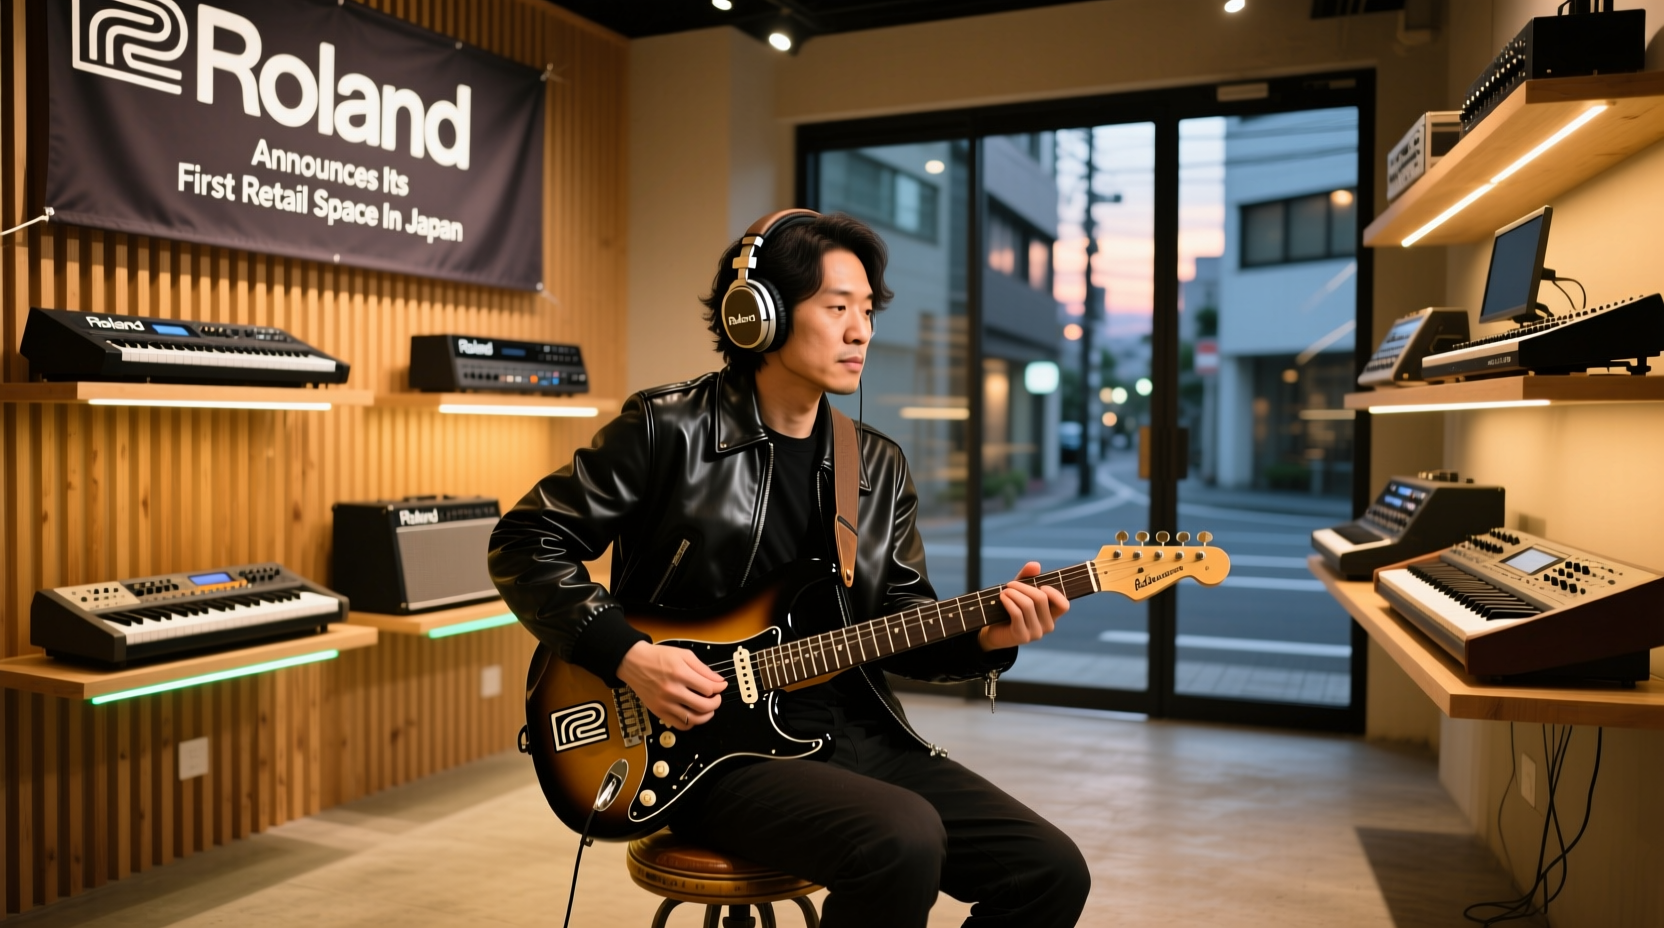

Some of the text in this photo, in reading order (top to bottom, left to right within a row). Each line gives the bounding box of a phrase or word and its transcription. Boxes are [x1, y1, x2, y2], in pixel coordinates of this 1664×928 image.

[197, 4, 471, 170] Roland
[178, 162, 464, 244] First Retail Space In Japan
[251, 138, 409, 197] Announces Its
